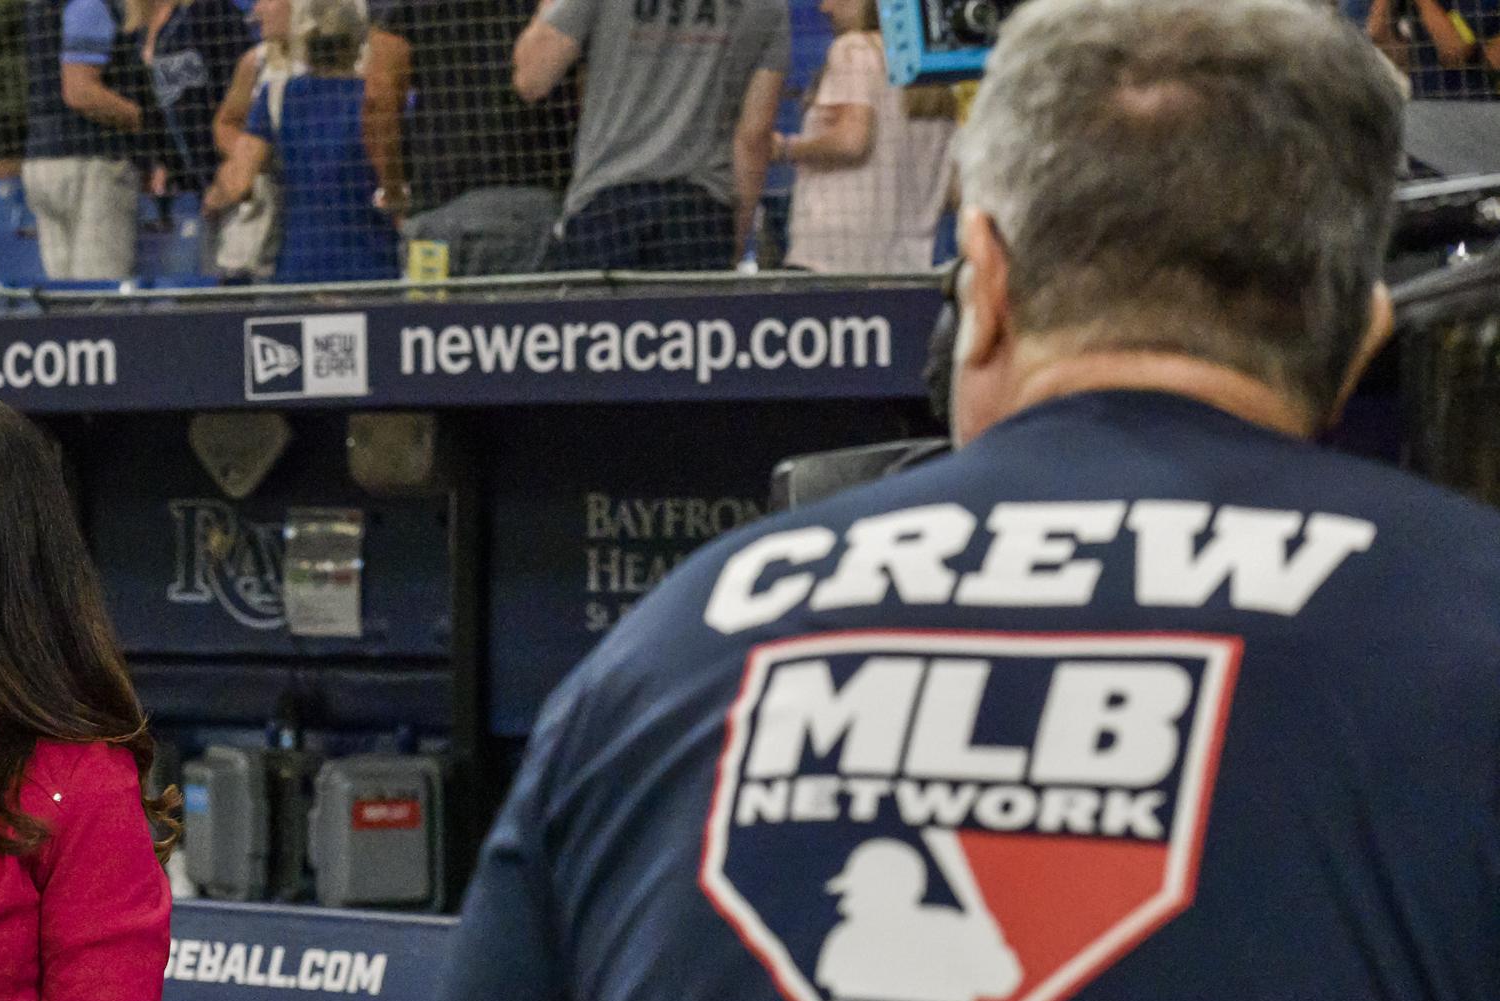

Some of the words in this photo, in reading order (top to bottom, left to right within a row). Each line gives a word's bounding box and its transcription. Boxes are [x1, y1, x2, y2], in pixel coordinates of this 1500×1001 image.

[401, 316, 891, 383] neweracap.com
[704, 500, 1377, 635] CREW
[745, 656, 1193, 788] MLB
[735, 775, 1168, 839] NETWORK
